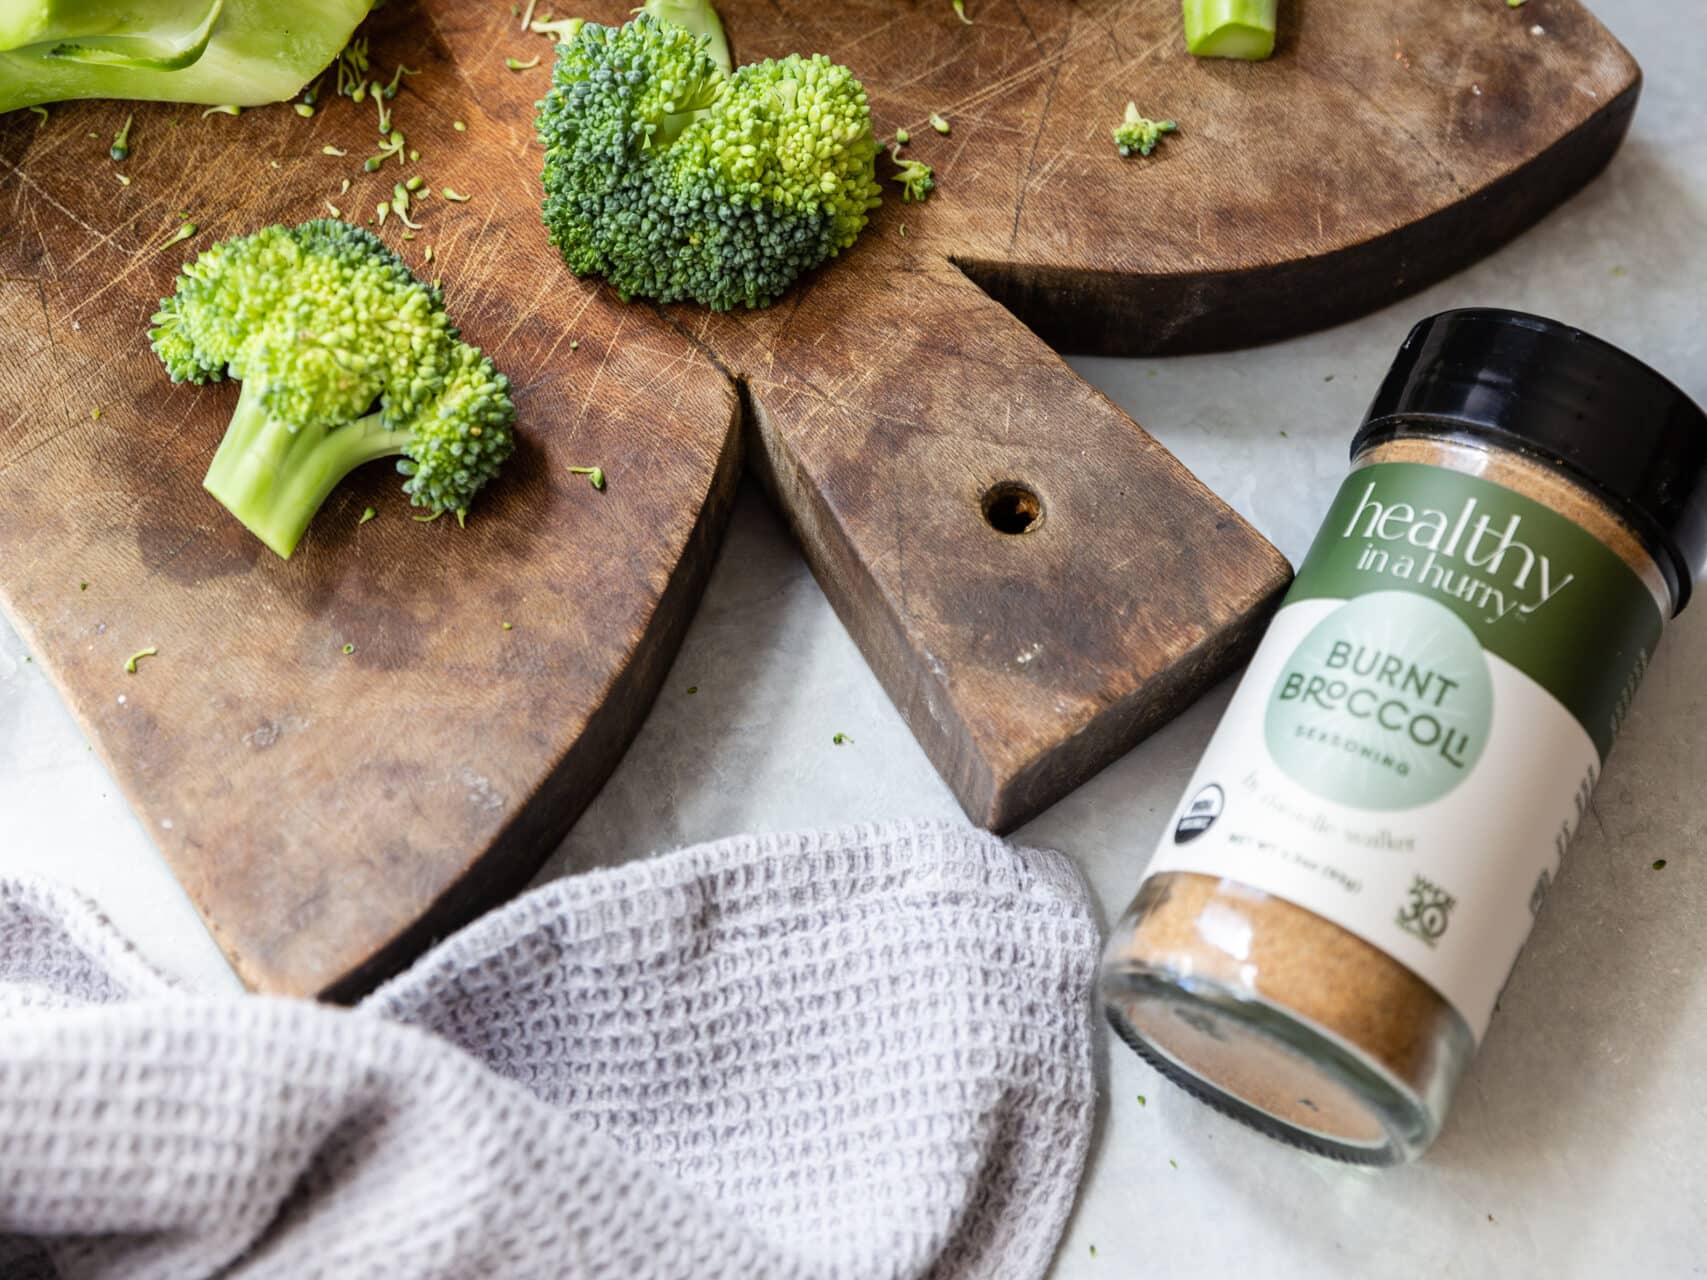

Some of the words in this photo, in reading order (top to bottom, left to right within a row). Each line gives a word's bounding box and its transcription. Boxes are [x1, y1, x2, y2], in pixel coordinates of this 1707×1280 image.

[1343, 481, 1574, 613] healthy
[1356, 543, 1389, 573] in
[1391, 556, 1415, 579] a
[1418, 552, 1518, 624] hurry
[1325, 640, 1460, 708] BURNT
[1279, 672, 1470, 769] BROCCOLI
[1294, 723, 1411, 777] SEASONING
